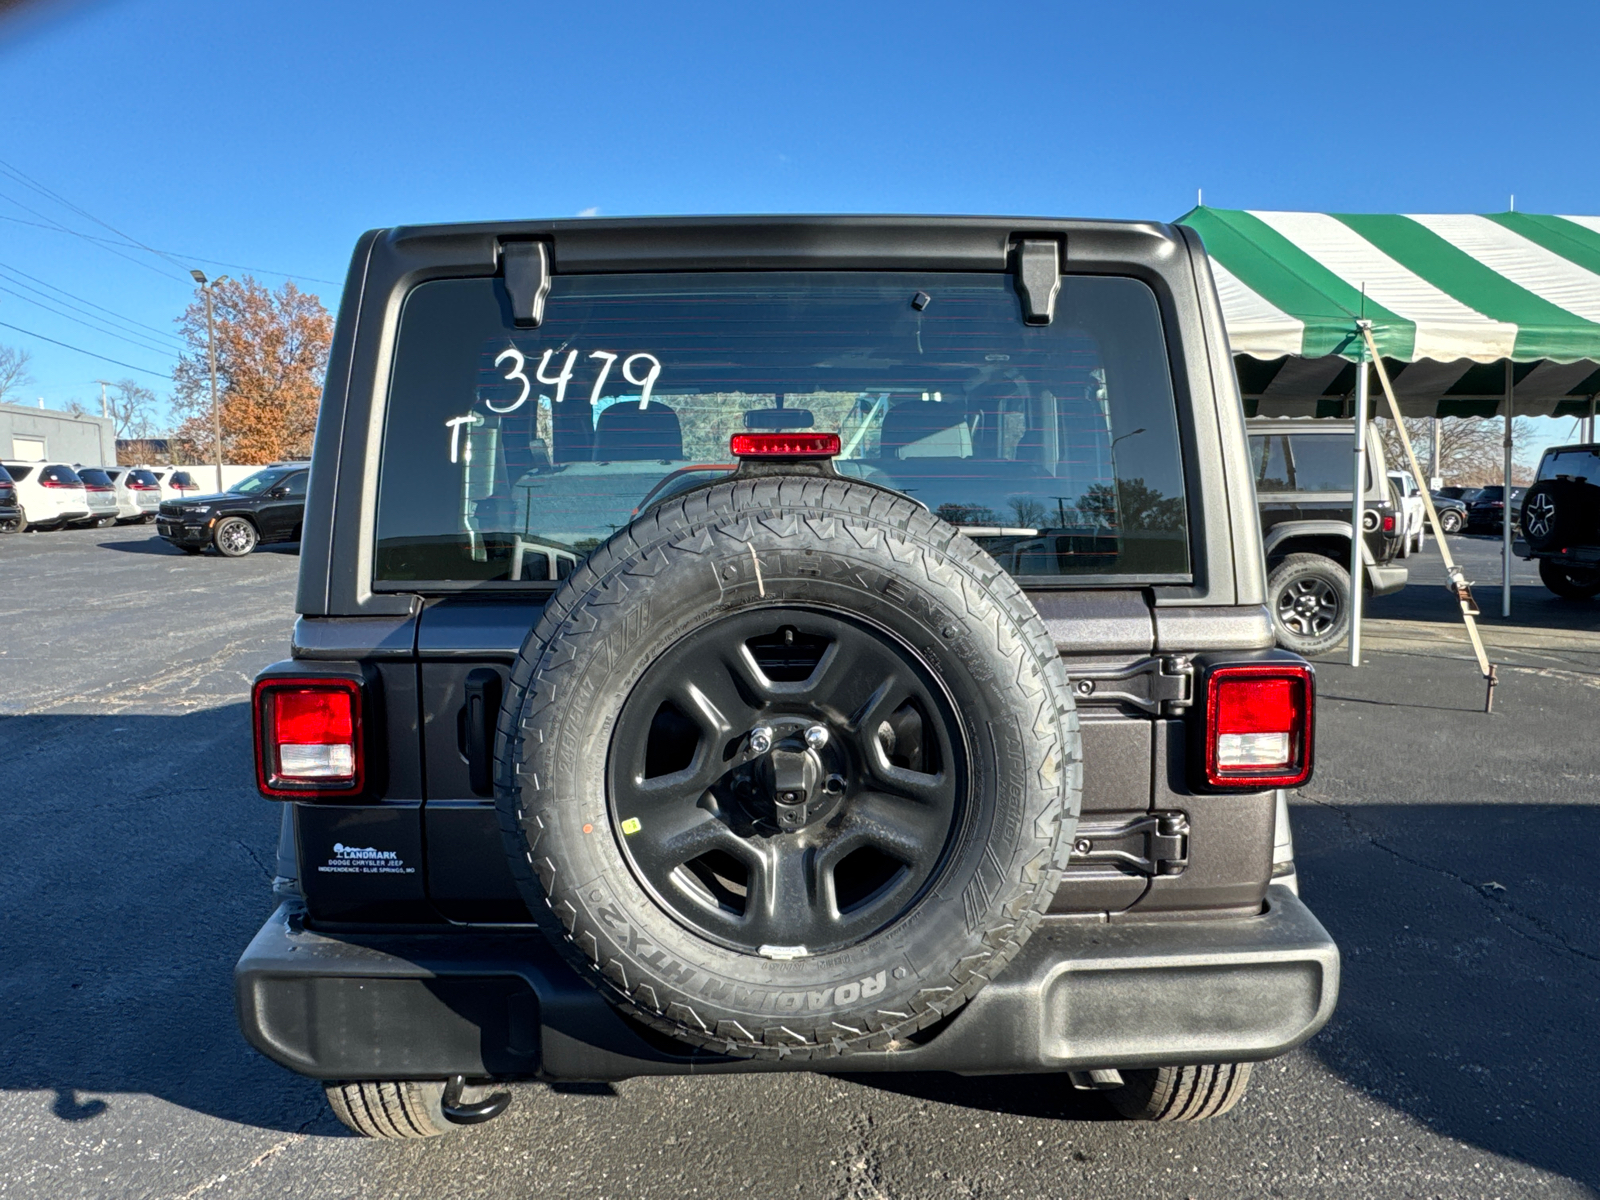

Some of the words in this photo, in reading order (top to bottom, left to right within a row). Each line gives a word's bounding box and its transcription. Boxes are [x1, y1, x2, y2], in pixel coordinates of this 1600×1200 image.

[485, 349, 661, 413] 3479
[744, 554, 941, 629] NEXEN
[344, 851, 397, 859] LANDMARK
[700, 969, 887, 1013] ROADIAN
